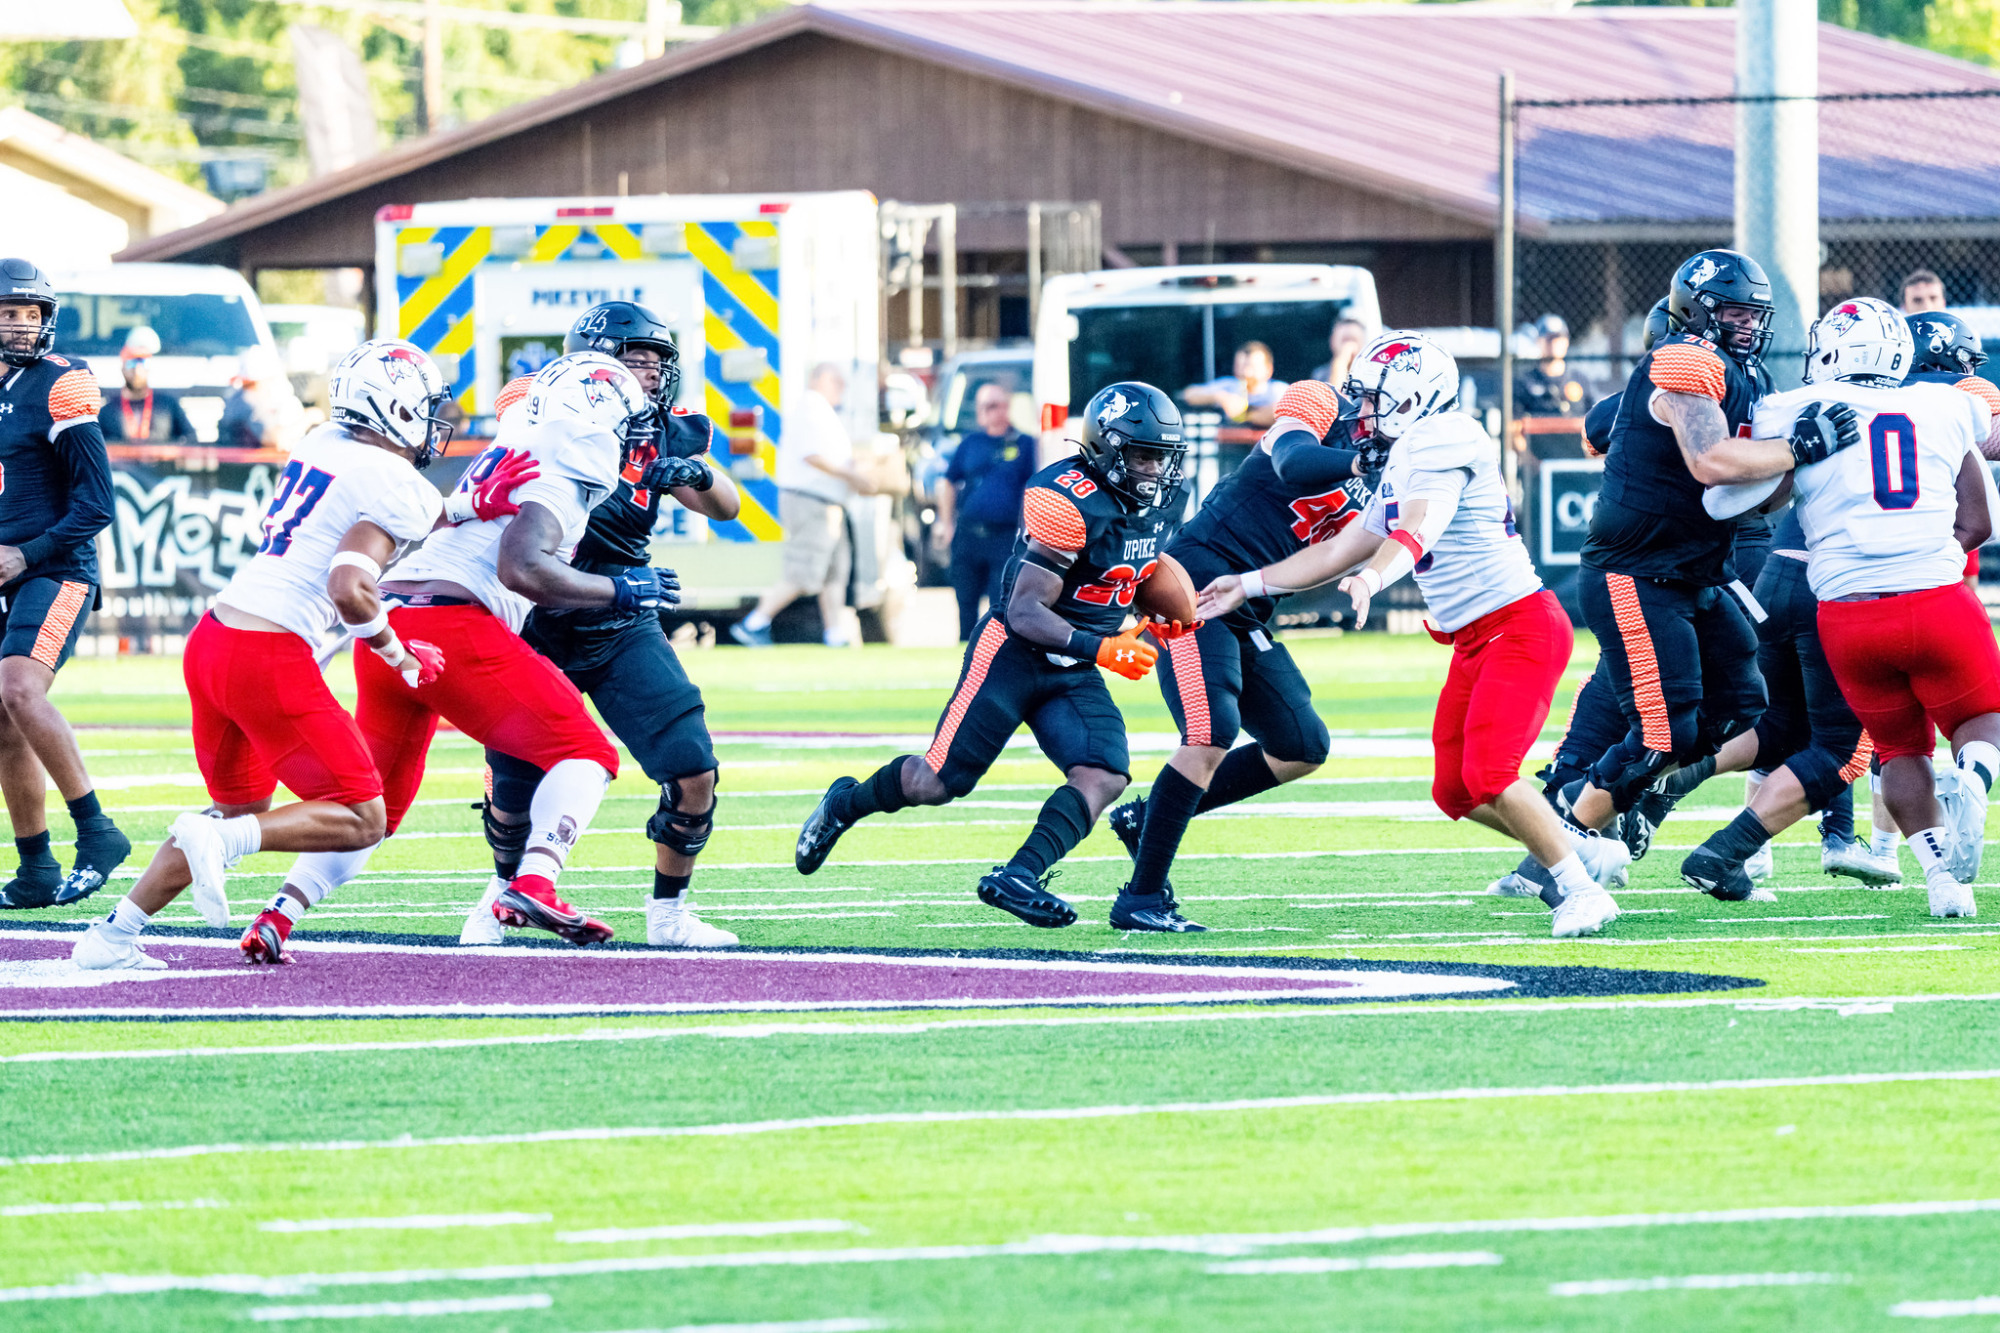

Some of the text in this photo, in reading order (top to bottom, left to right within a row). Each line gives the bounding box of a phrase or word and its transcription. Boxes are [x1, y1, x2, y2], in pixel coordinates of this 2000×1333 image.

[1868, 412, 1920, 511] 0
[1054, 469, 1098, 499] 28
[1345, 476, 1373, 508] UPIK
[1123, 537, 1157, 561] UPIKE
